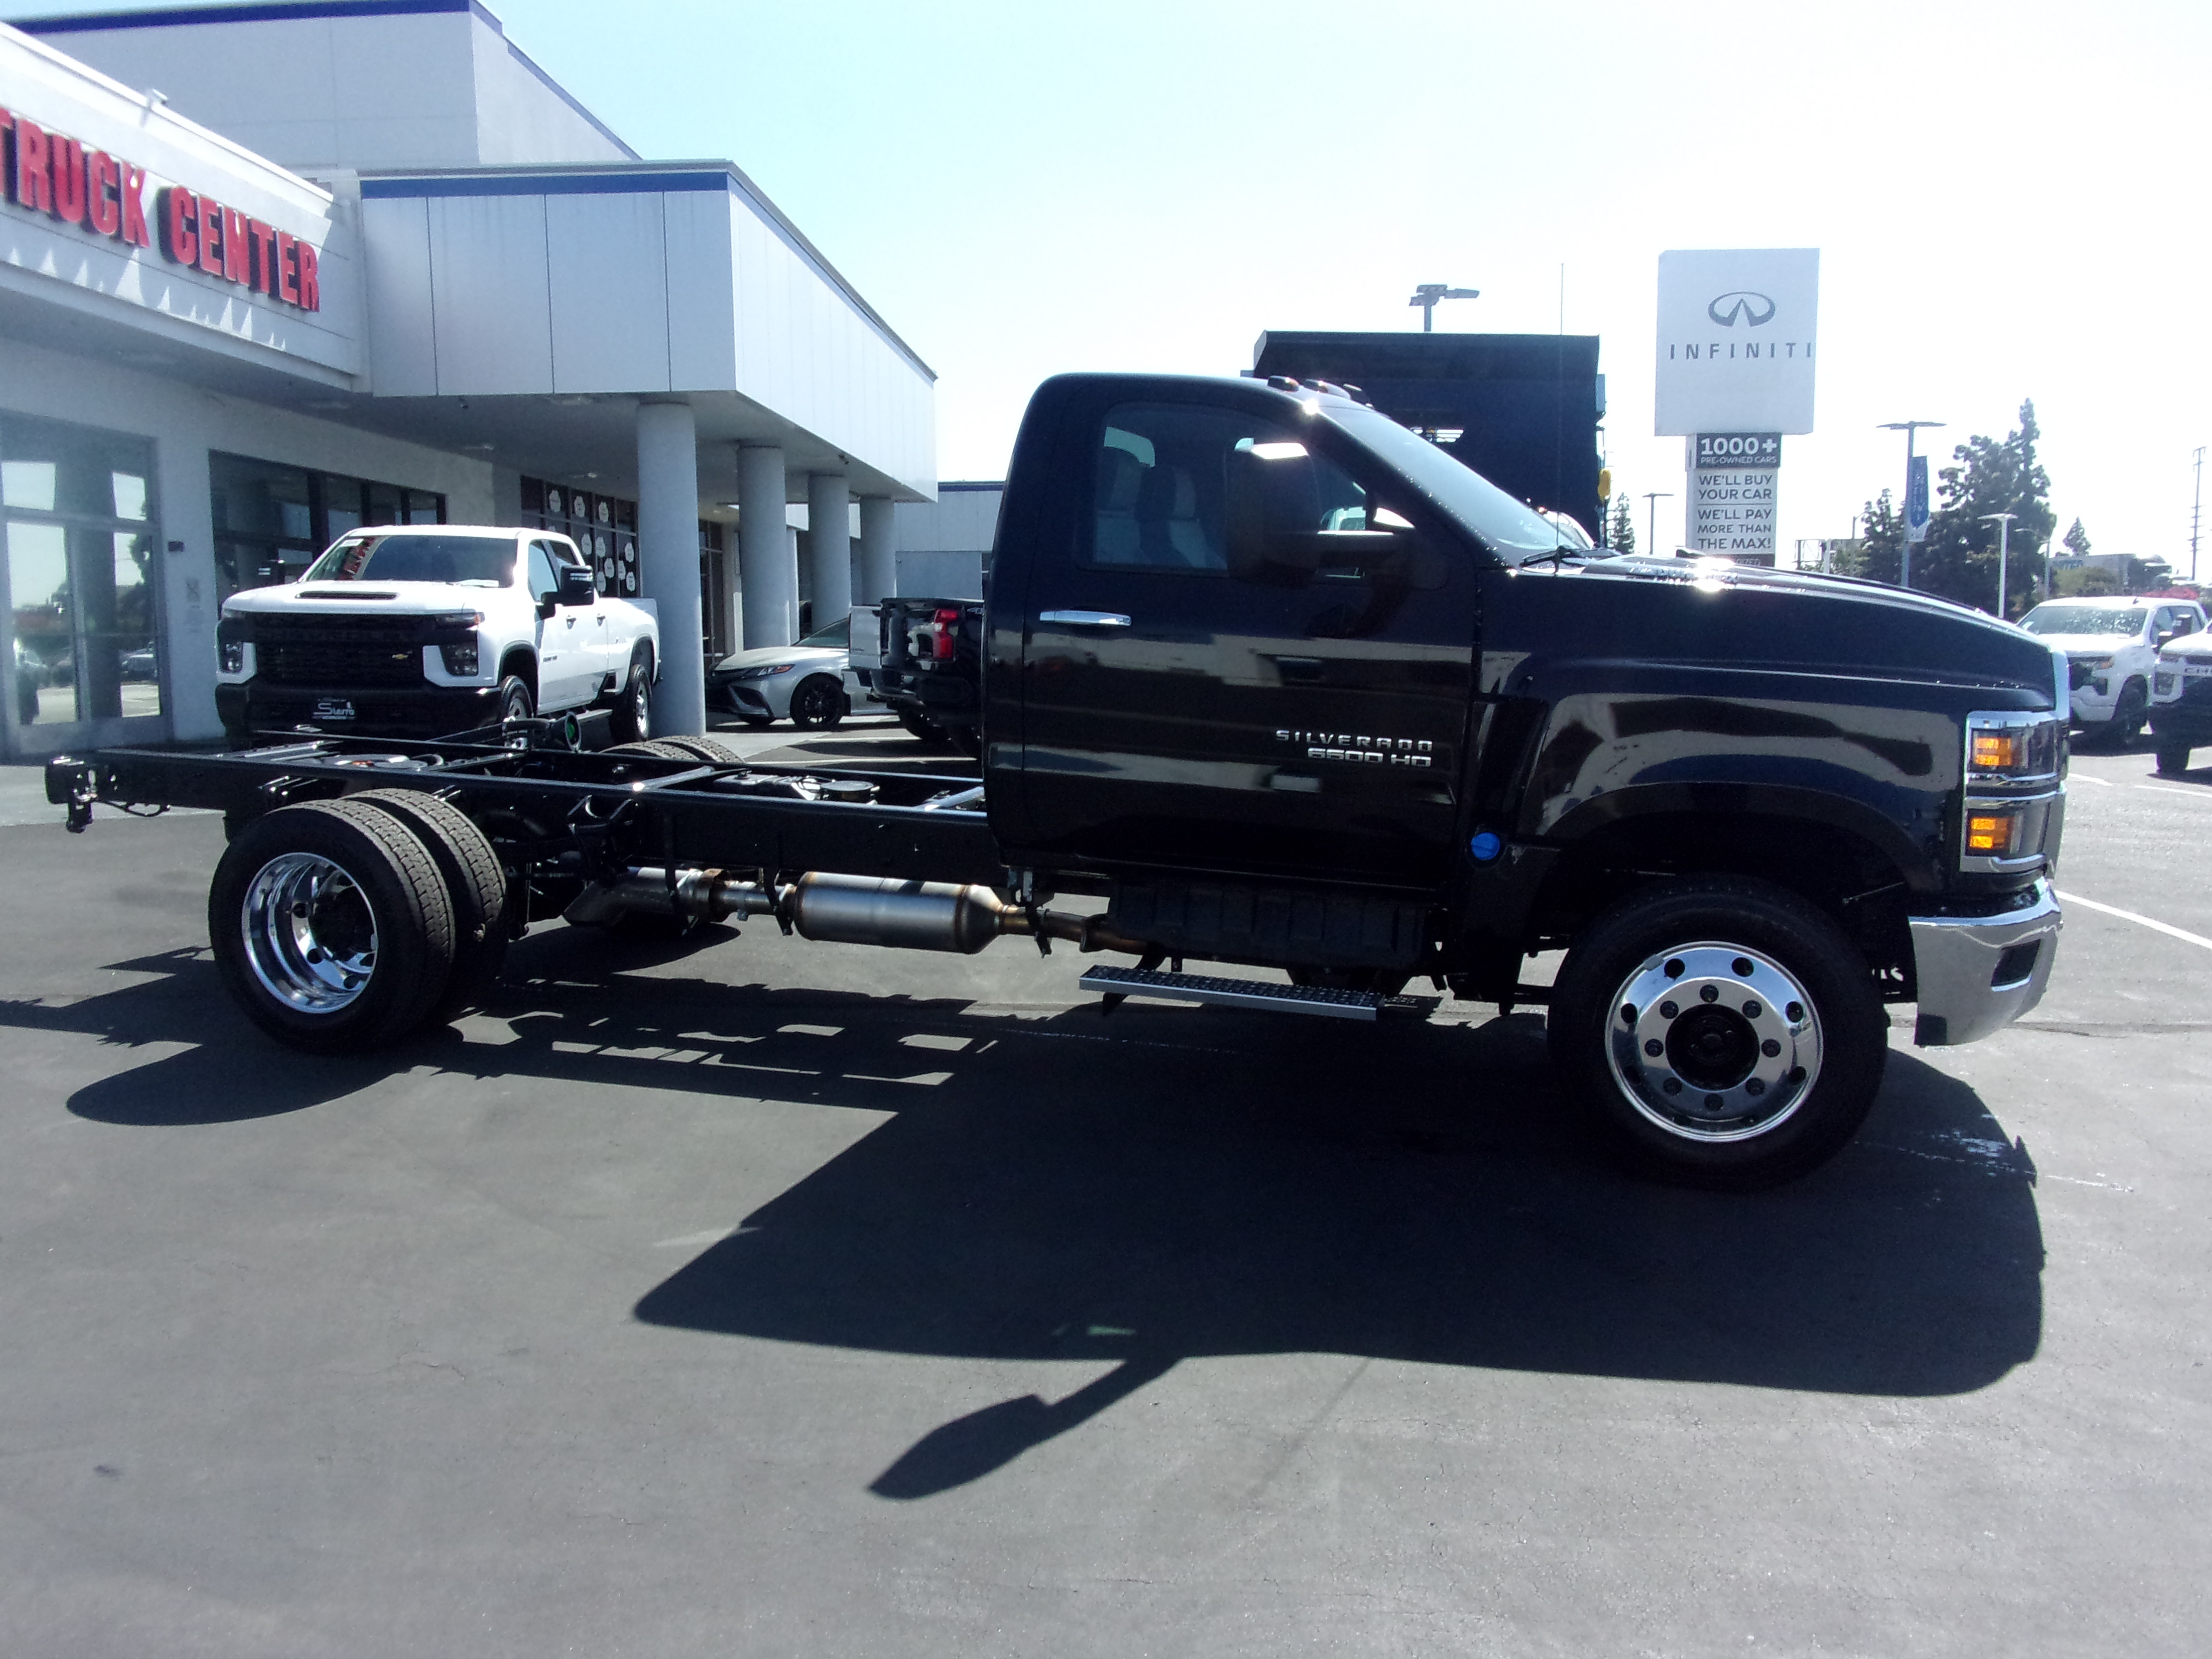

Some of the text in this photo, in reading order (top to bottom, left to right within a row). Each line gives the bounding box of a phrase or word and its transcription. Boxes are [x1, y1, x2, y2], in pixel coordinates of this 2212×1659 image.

[166, 186, 320, 313] CENTER
[1670, 342, 1812, 360] INFINITI
[1698, 474, 1773, 485] WE'LL BUY
[1698, 489, 1772, 500] YOUR CAR
[1697, 509, 1772, 520] WE'LL PAY
[1697, 524, 1771, 533] MORE THAN
[1697, 538, 1771, 549] THE MAX!
[1276, 729, 1433, 752] SILVERADO
[1307, 747, 1432, 768] 6500 HD
